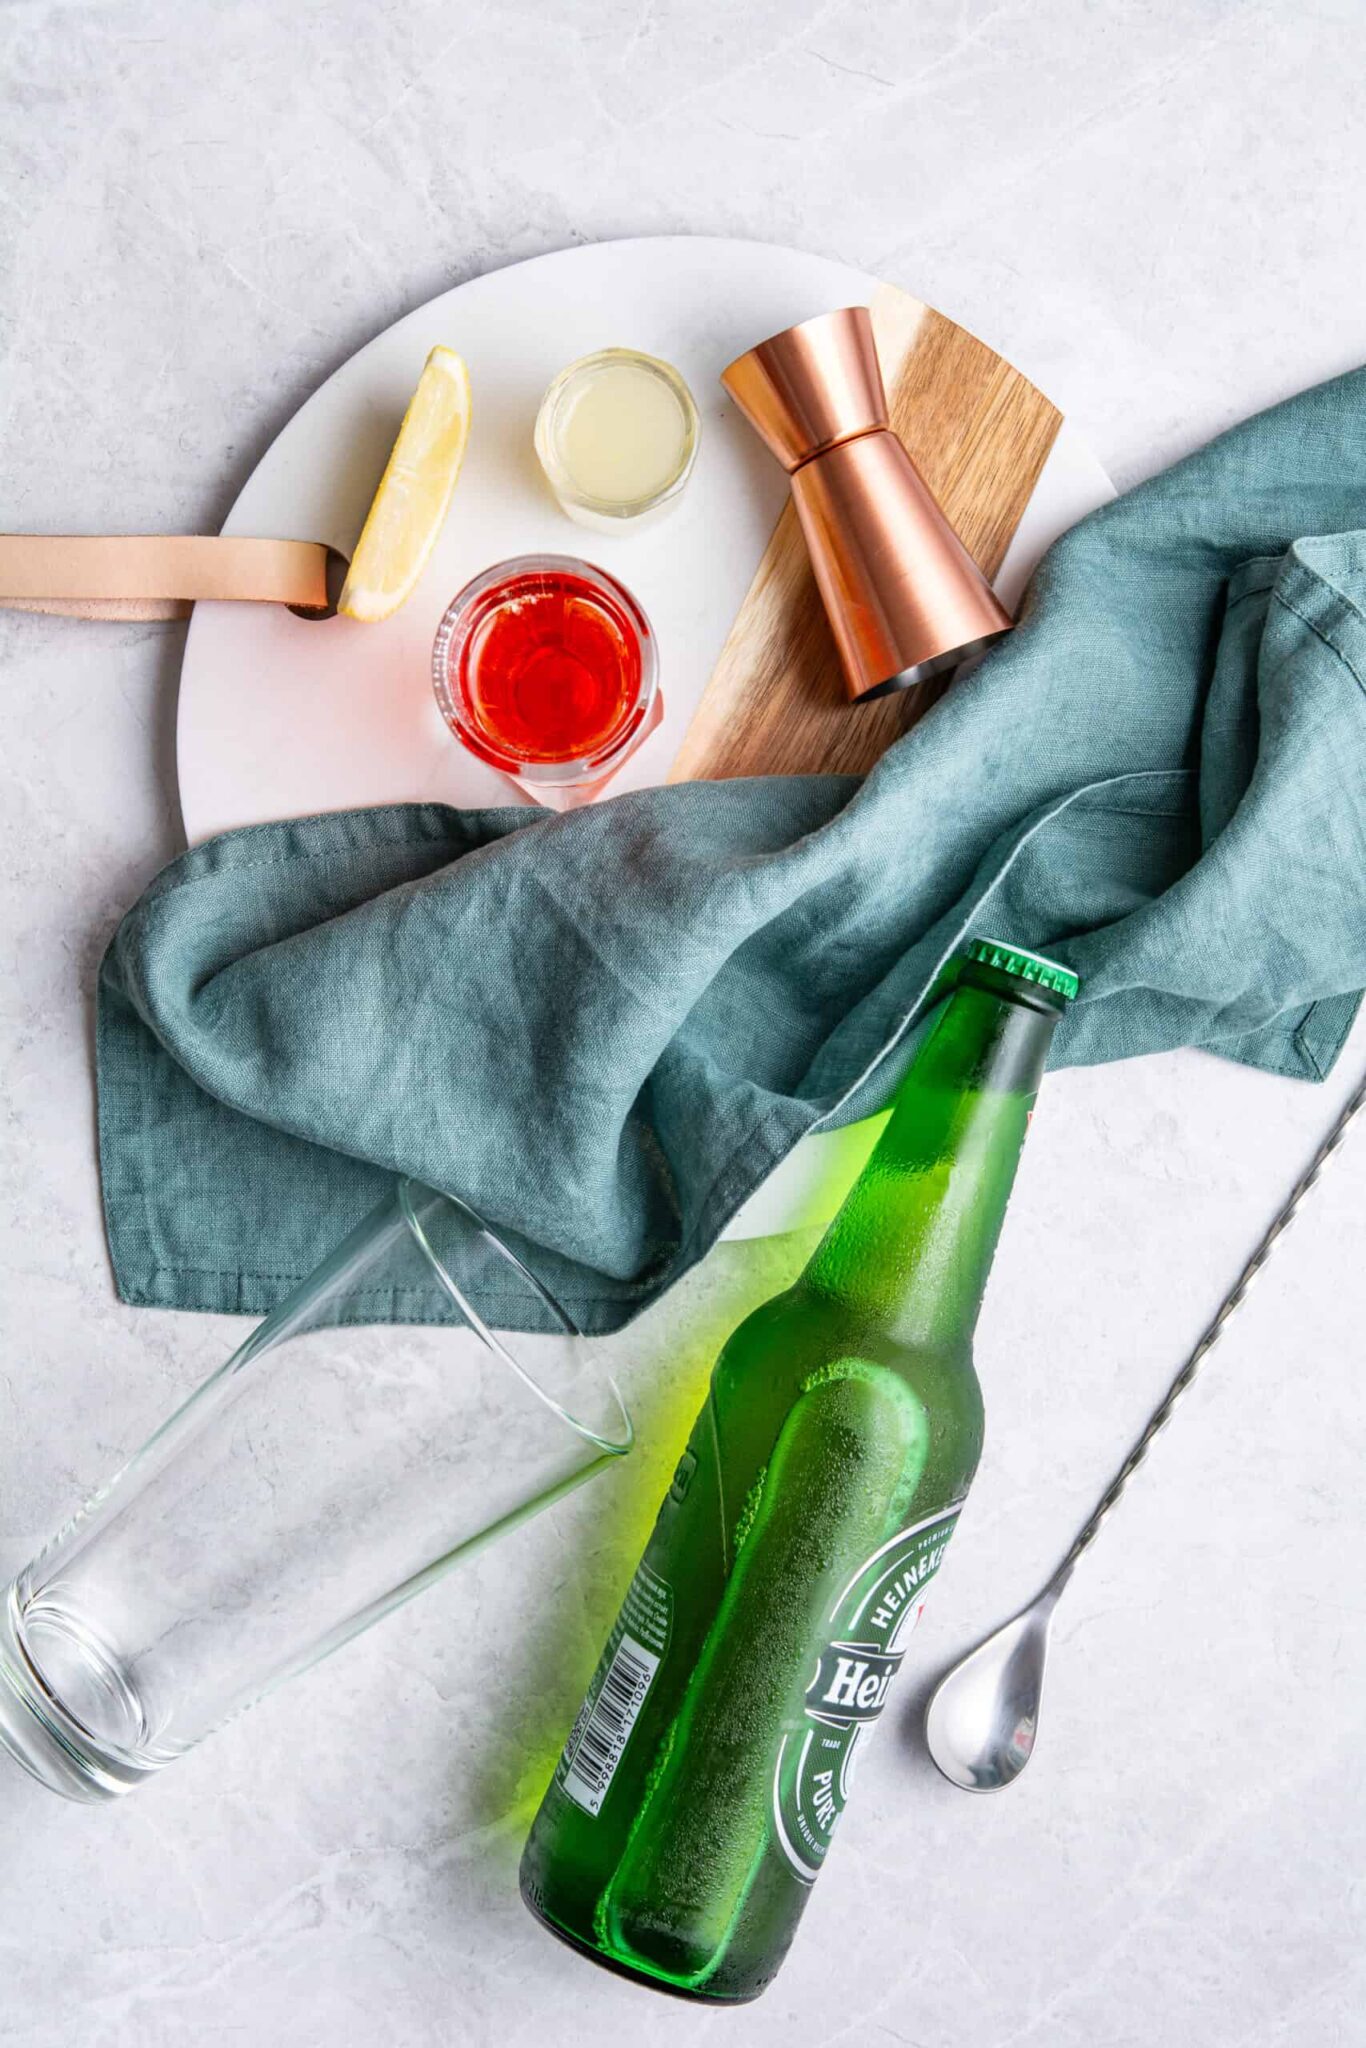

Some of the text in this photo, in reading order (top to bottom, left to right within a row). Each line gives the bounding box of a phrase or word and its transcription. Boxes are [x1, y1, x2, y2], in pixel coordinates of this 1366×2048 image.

[597, 1735, 626, 1790] 998818
[623, 1673, 651, 1727] 171096
[821, 1738, 841, 1749] TRADE
[813, 1770, 836, 1831] PURE
[797, 1813, 814, 1847] UNIQUE
